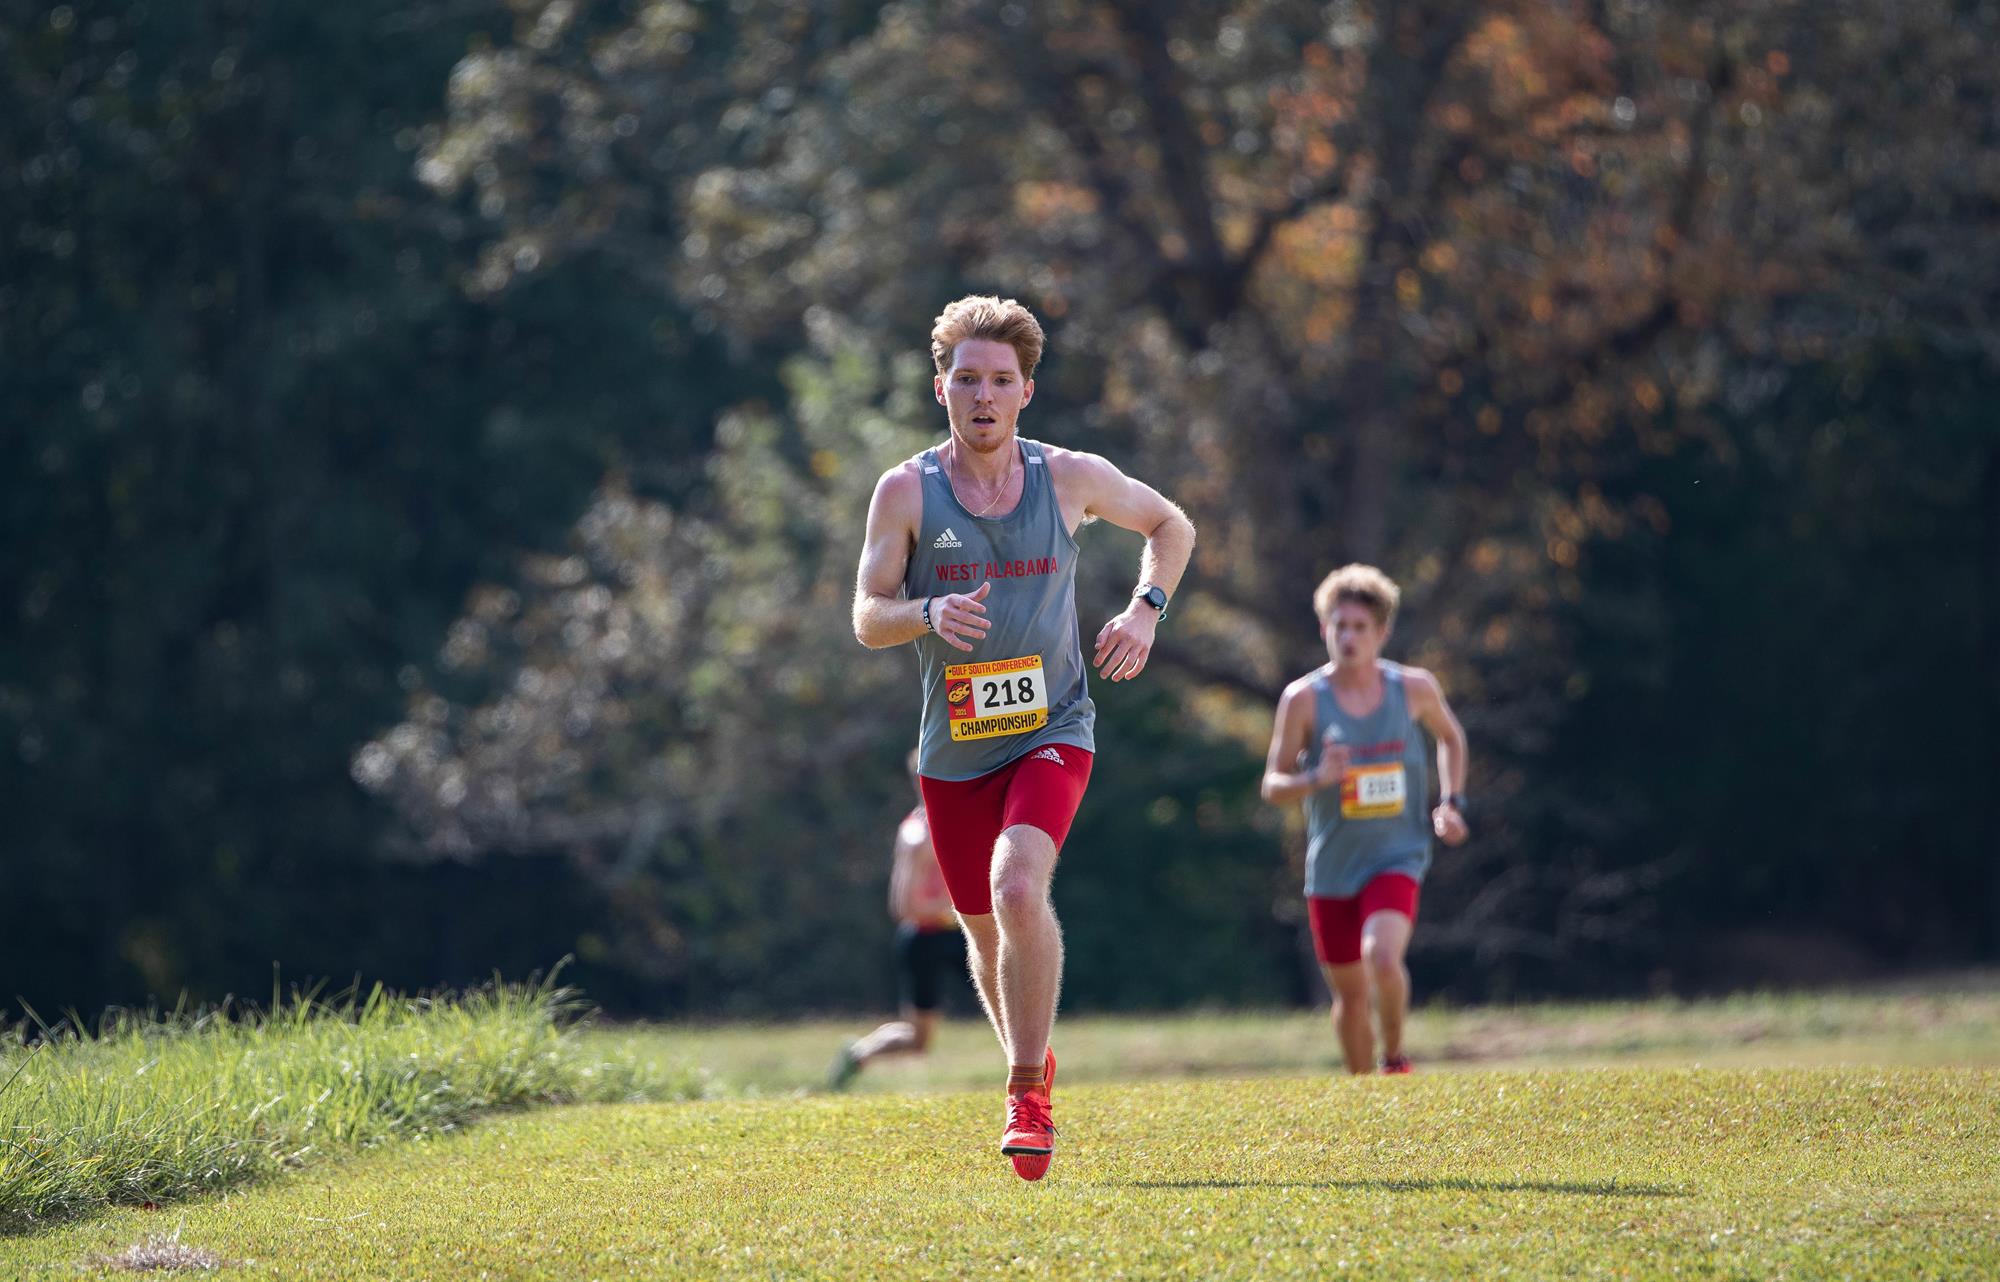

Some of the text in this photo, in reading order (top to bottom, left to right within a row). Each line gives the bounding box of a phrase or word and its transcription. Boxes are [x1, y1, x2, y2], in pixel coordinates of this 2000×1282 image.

[933, 540, 963, 549] adidas
[935, 557, 1058, 581] WEST ALABAMA
[951, 657, 1036, 676] GULF SOUTH CONFERENCE
[982, 676, 1035, 709] 218
[960, 713, 1038, 736] CHAMPIONSHIP
[1030, 754, 1065, 766] adidas
